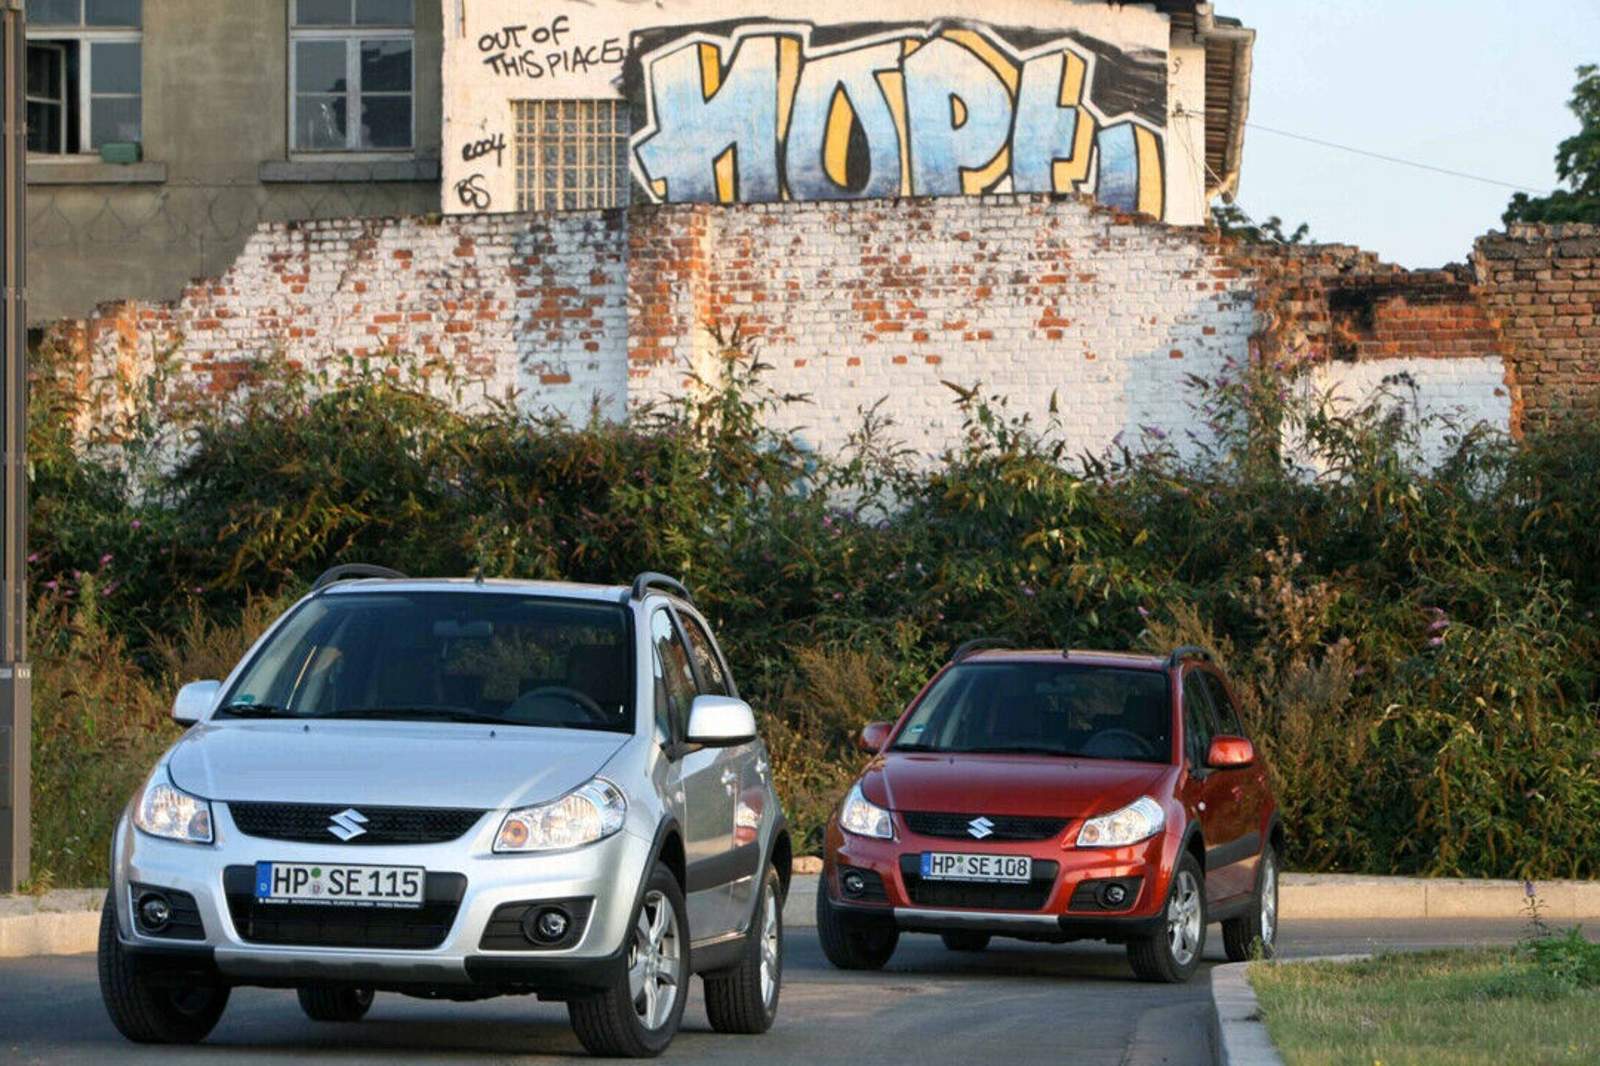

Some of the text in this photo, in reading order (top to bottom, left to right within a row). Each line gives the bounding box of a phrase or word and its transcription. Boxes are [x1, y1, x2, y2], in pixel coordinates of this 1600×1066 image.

[478, 15, 570, 52] OUT OF
[483, 50, 545, 79] THIS
[932, 855, 1028, 876] HP SE 108
[273, 867, 419, 897] HP SE 115
